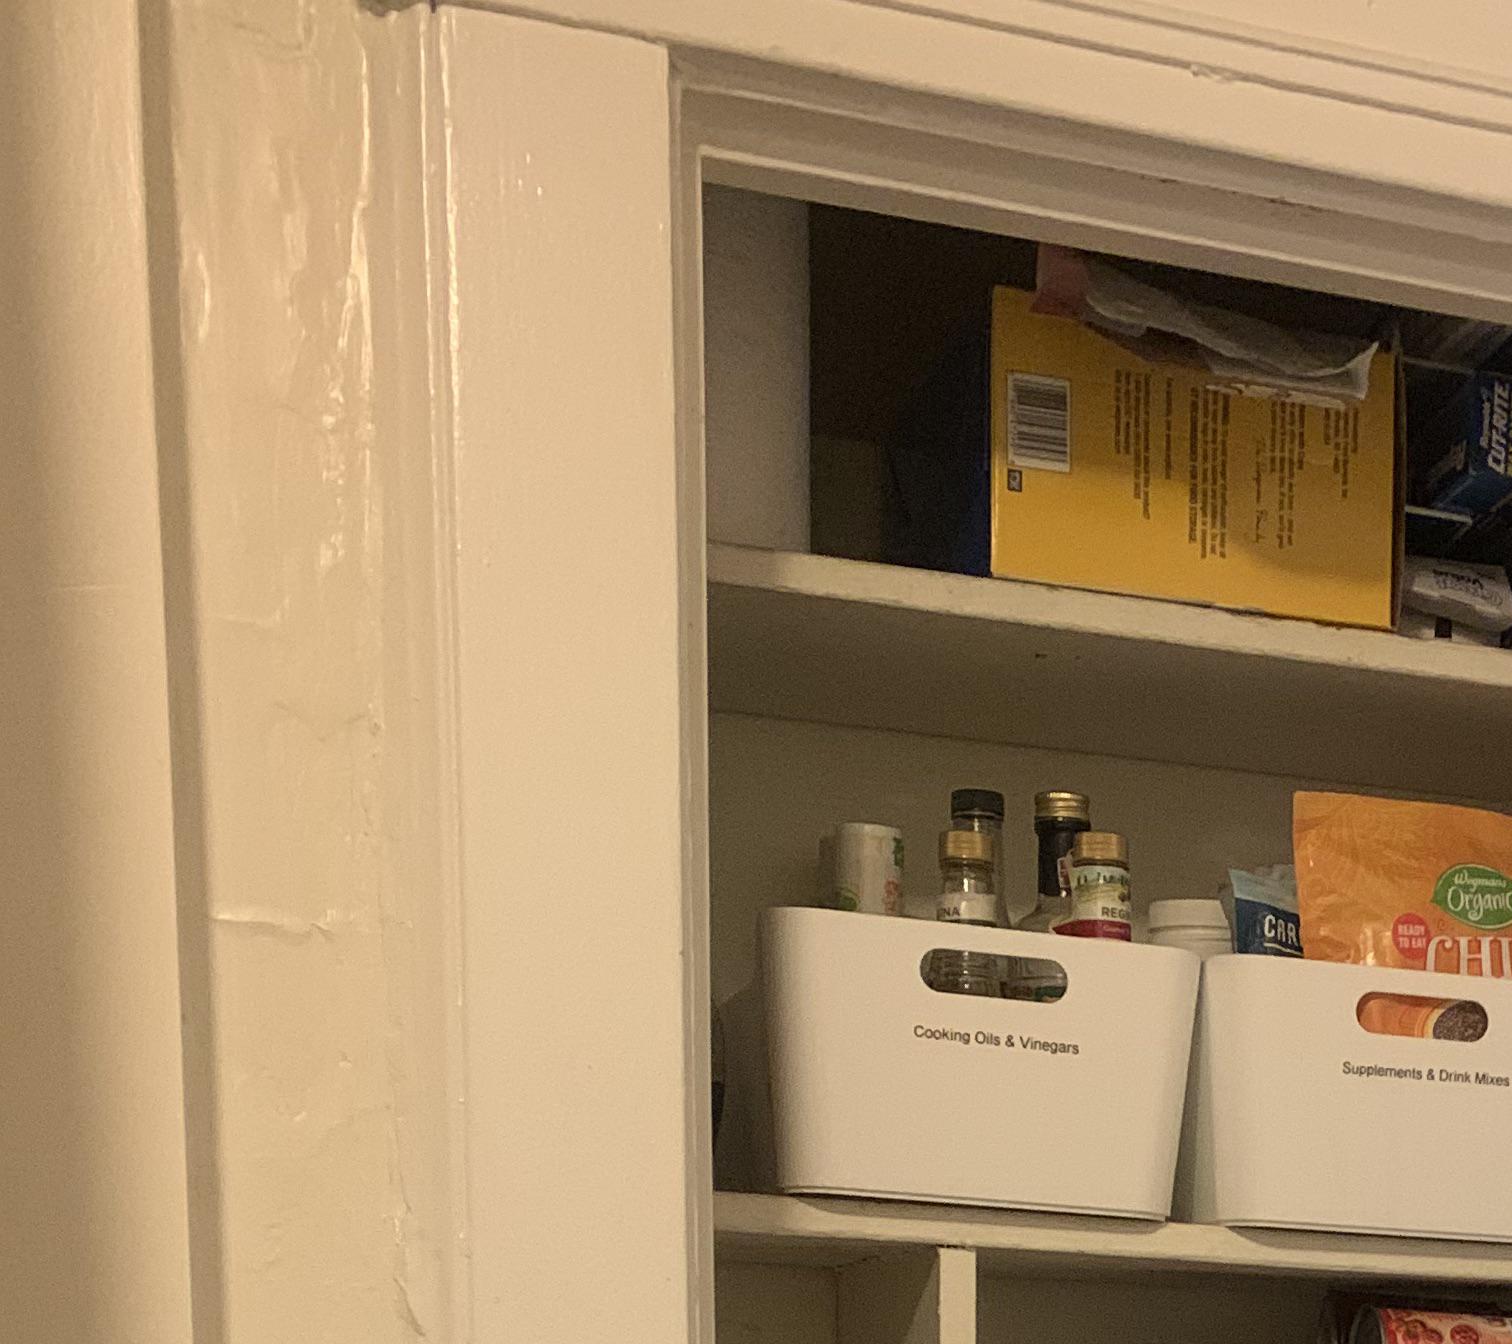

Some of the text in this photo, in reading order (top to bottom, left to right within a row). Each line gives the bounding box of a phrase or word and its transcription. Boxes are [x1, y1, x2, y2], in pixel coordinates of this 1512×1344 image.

[1453, 869, 1507, 892] Wegmans
[1398, 924, 1425, 936] READY
[1399, 936, 1411, 948] TO
[913, 1024, 1080, 1055] Cooking Oils & Vinegars
[1342, 1061, 1510, 1087] Supplements & Drink Mixes
